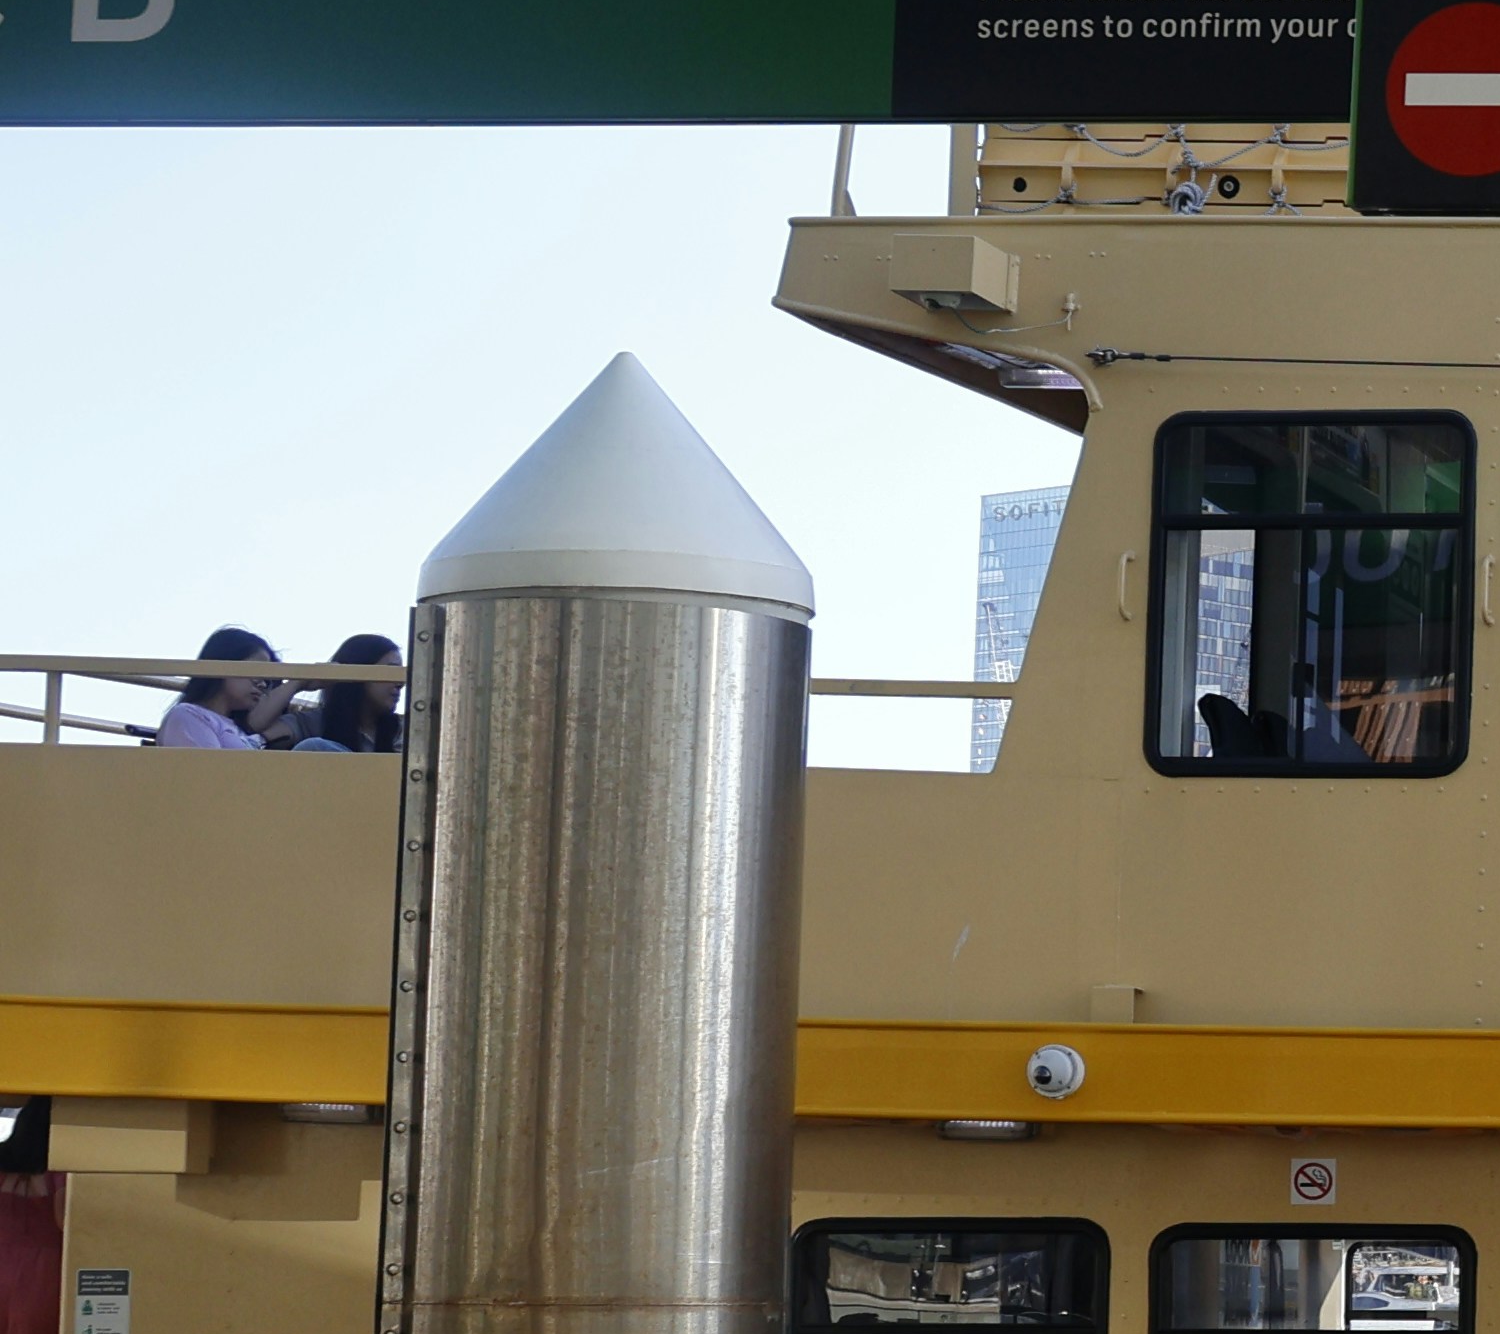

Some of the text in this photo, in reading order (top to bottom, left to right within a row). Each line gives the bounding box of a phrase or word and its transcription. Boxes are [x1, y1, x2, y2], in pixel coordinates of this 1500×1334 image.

[977, 18, 1095, 39] screens
[1102, 14, 1134, 39] to
[1142, 12, 1263, 39] confirm
[1269, 18, 1340, 44] your
